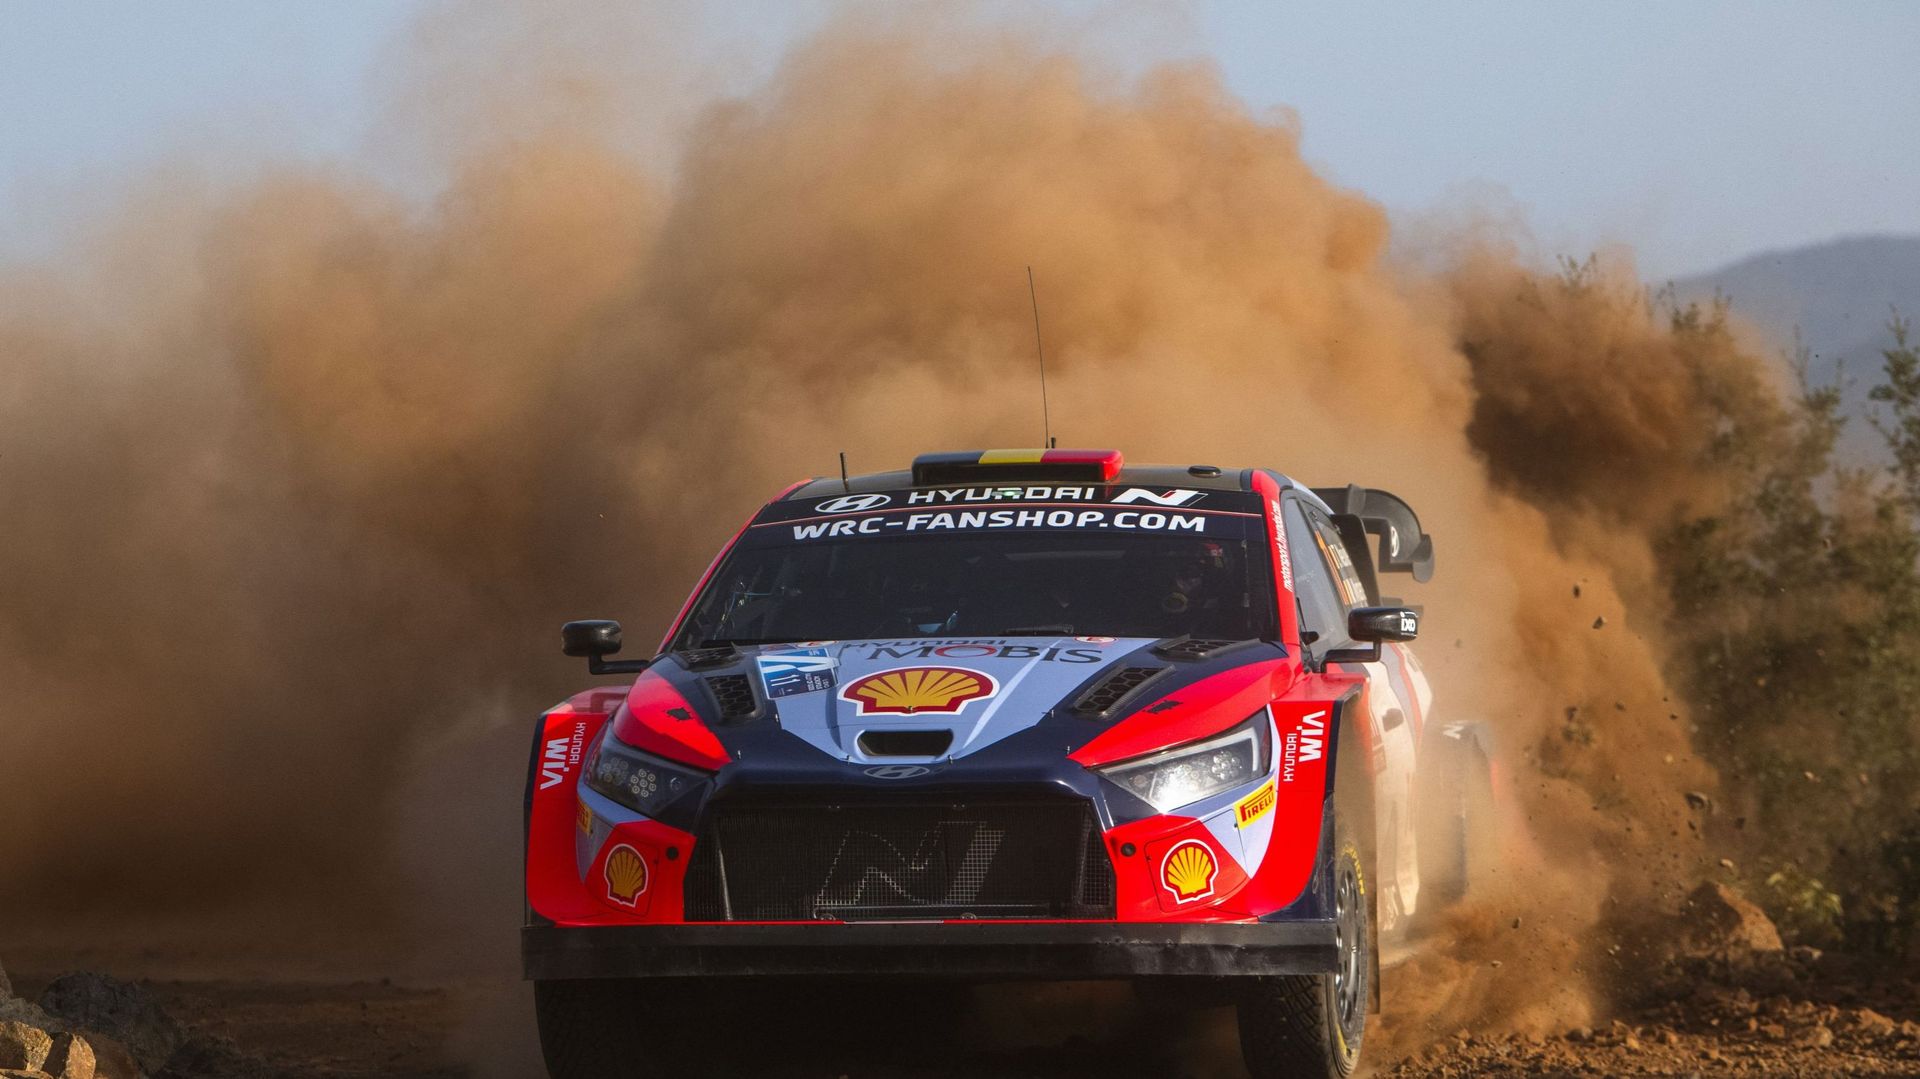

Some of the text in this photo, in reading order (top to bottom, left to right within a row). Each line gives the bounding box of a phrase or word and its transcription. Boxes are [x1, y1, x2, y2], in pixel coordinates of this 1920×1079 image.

[908, 487, 1095, 504] HYUNDAI
[793, 511, 1206, 540] WRC-FANSHOP.COM
[868, 645, 1103, 664] MOBIS
[569, 722, 587, 765] HYUNDAI
[1283, 733, 1298, 782] HYUNDAI
[1239, 784, 1274, 823] PIRELLI
